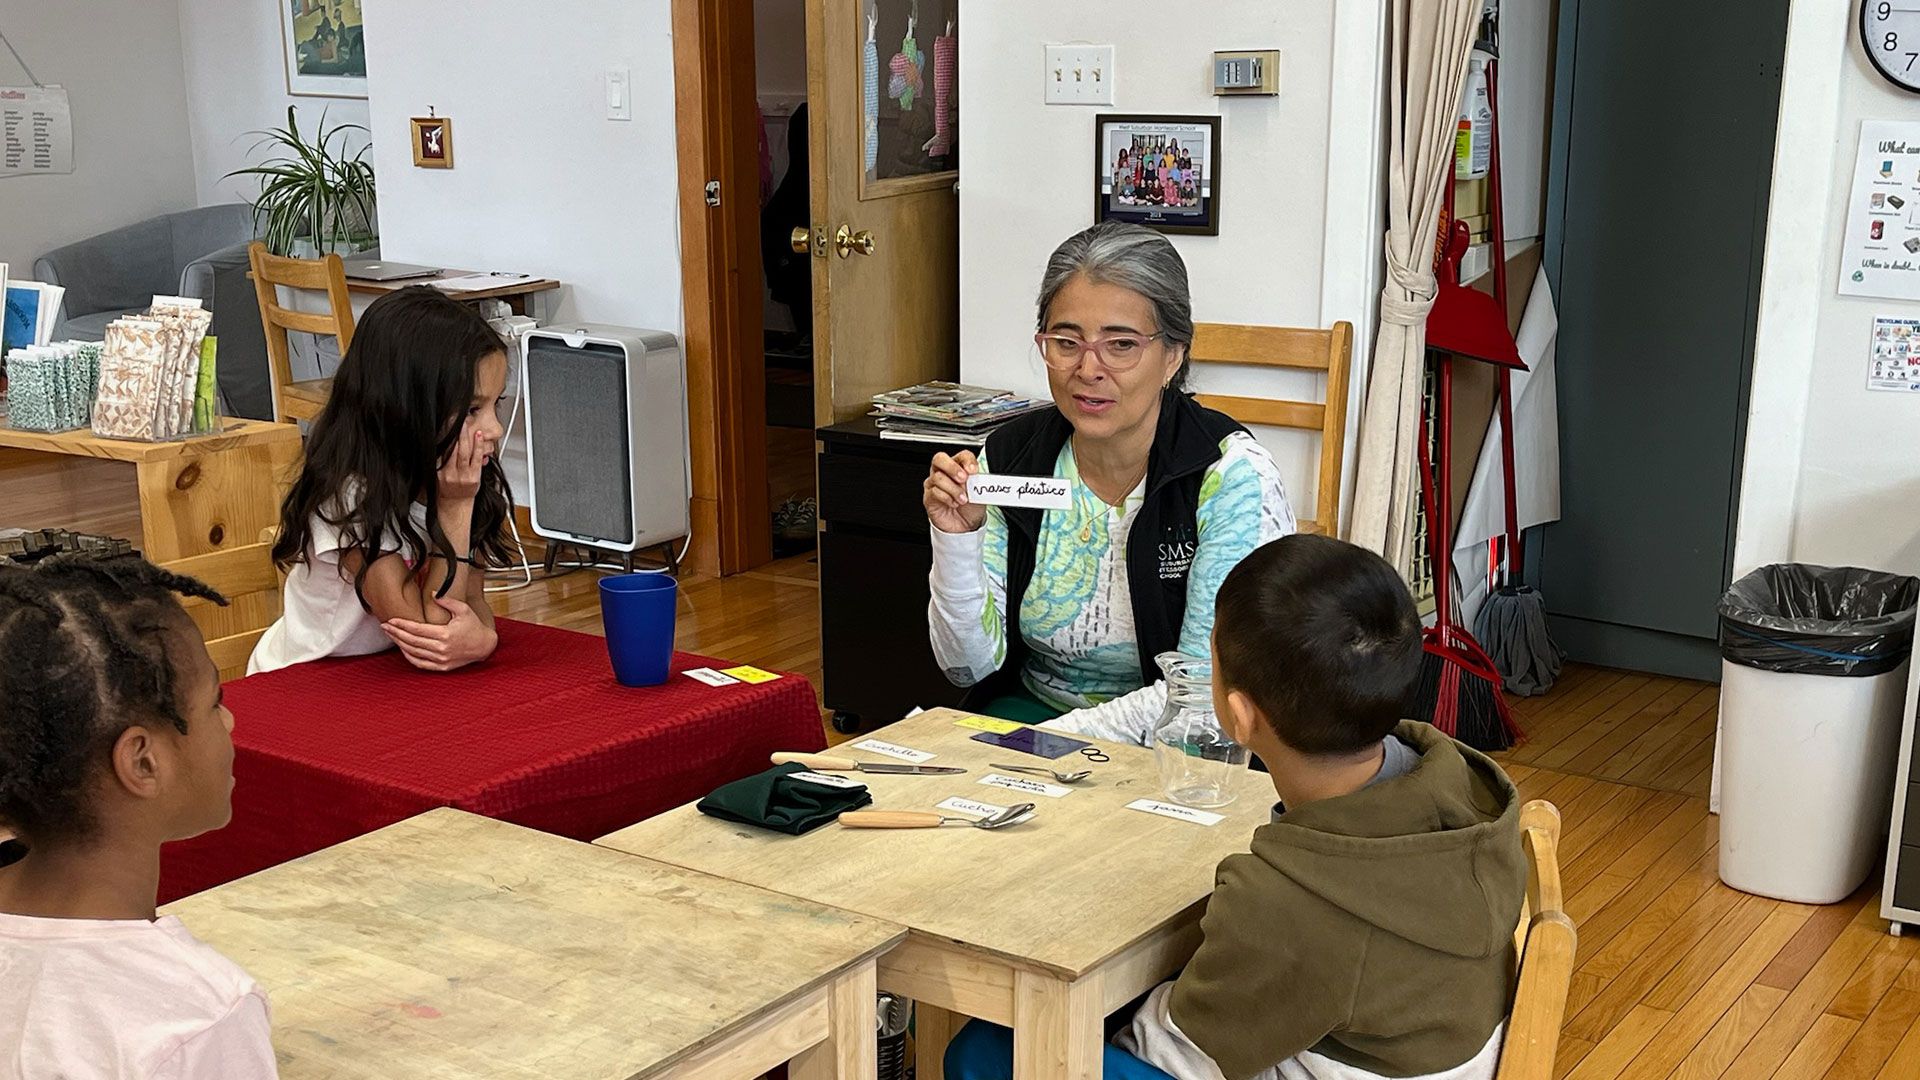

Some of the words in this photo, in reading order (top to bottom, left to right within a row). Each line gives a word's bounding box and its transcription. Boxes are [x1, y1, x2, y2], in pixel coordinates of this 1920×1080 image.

[1877, 2, 1891, 21] 9
[1883, 32, 1898, 51] 8
[1905, 53, 1919, 71] 7
[1878, 141, 1906, 153] What
[1861, 259, 1881, 269] When
[1883, 261, 1890, 269] in
[973, 485, 1011, 495] vaso
[1158, 540, 1195, 561] SMS
